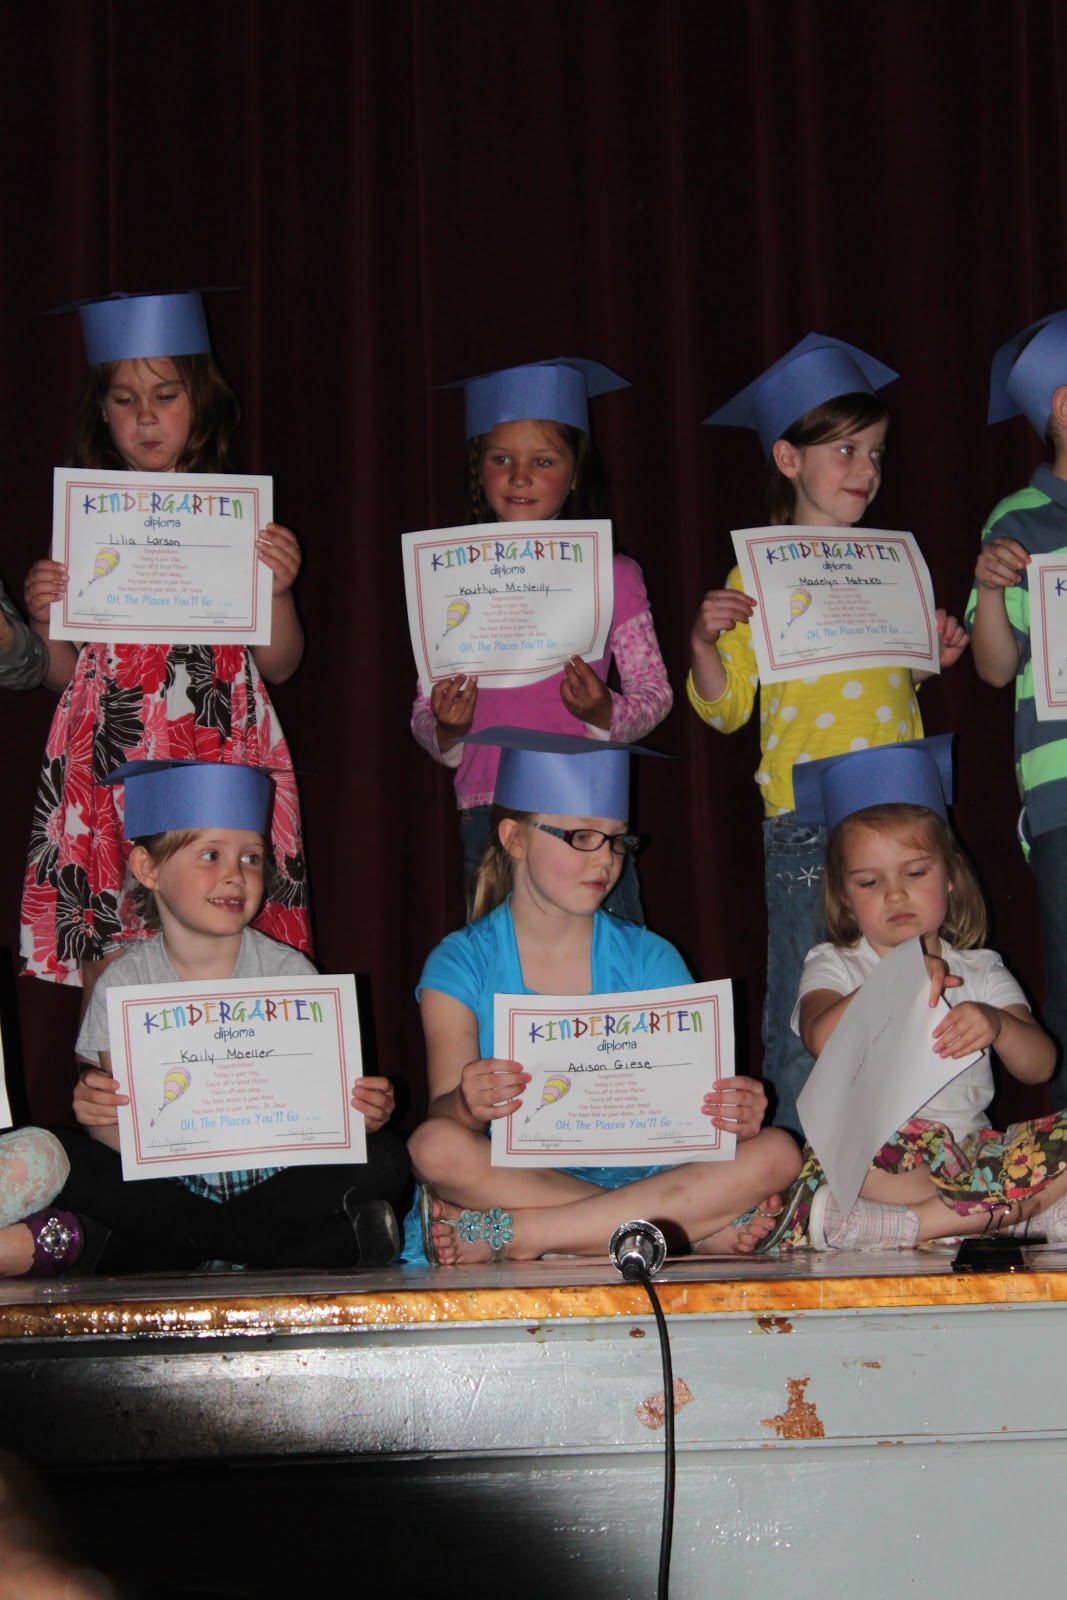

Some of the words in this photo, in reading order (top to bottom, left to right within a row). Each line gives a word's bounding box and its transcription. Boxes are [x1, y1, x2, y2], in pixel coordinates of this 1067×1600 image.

[82, 492, 243, 520] KINDERGARTEN
[144, 516, 181, 530] diploma
[109, 534, 136, 546] Lilia
[146, 534, 181, 546] Larson
[430, 540, 583, 572] KINDERGARTEN
[766, 542, 900, 564] KINDERGARTEN
[489, 564, 526, 578] diploma
[822, 562, 852, 572] diploma
[106, 594, 121, 606] OH,
[124, 594, 138, 605] The
[142, 594, 170, 606] Places
[173, 594, 198, 606] You'll
[824, 628, 837, 637] The
[839, 626, 864, 635] Places
[460, 642, 474, 653] OH,
[477, 641, 491, 651] The
[494, 641, 518, 651] Places
[144, 998, 324, 1034] KINDERGARTEN
[213, 1026, 255, 1043] diploma
[528, 1010, 703, 1044] KINDERGARTEN
[596, 1038, 637, 1054] diploma
[180, 1050, 215, 1065] Kaily
[226, 1048, 274, 1059] Moeller
[568, 1062, 606, 1073] Adison
[614, 1060, 652, 1070] Giese
[180, 1119, 197, 1130] OH,
[200, 1117, 216, 1128] The
[220, 1115, 251, 1127] Places
[254, 1111, 283, 1124] You'll
[555, 1120, 572, 1131] OH,
[575, 1119, 591, 1130] The
[595, 1118, 625, 1129] Places
[629, 1117, 657, 1128] You'll
